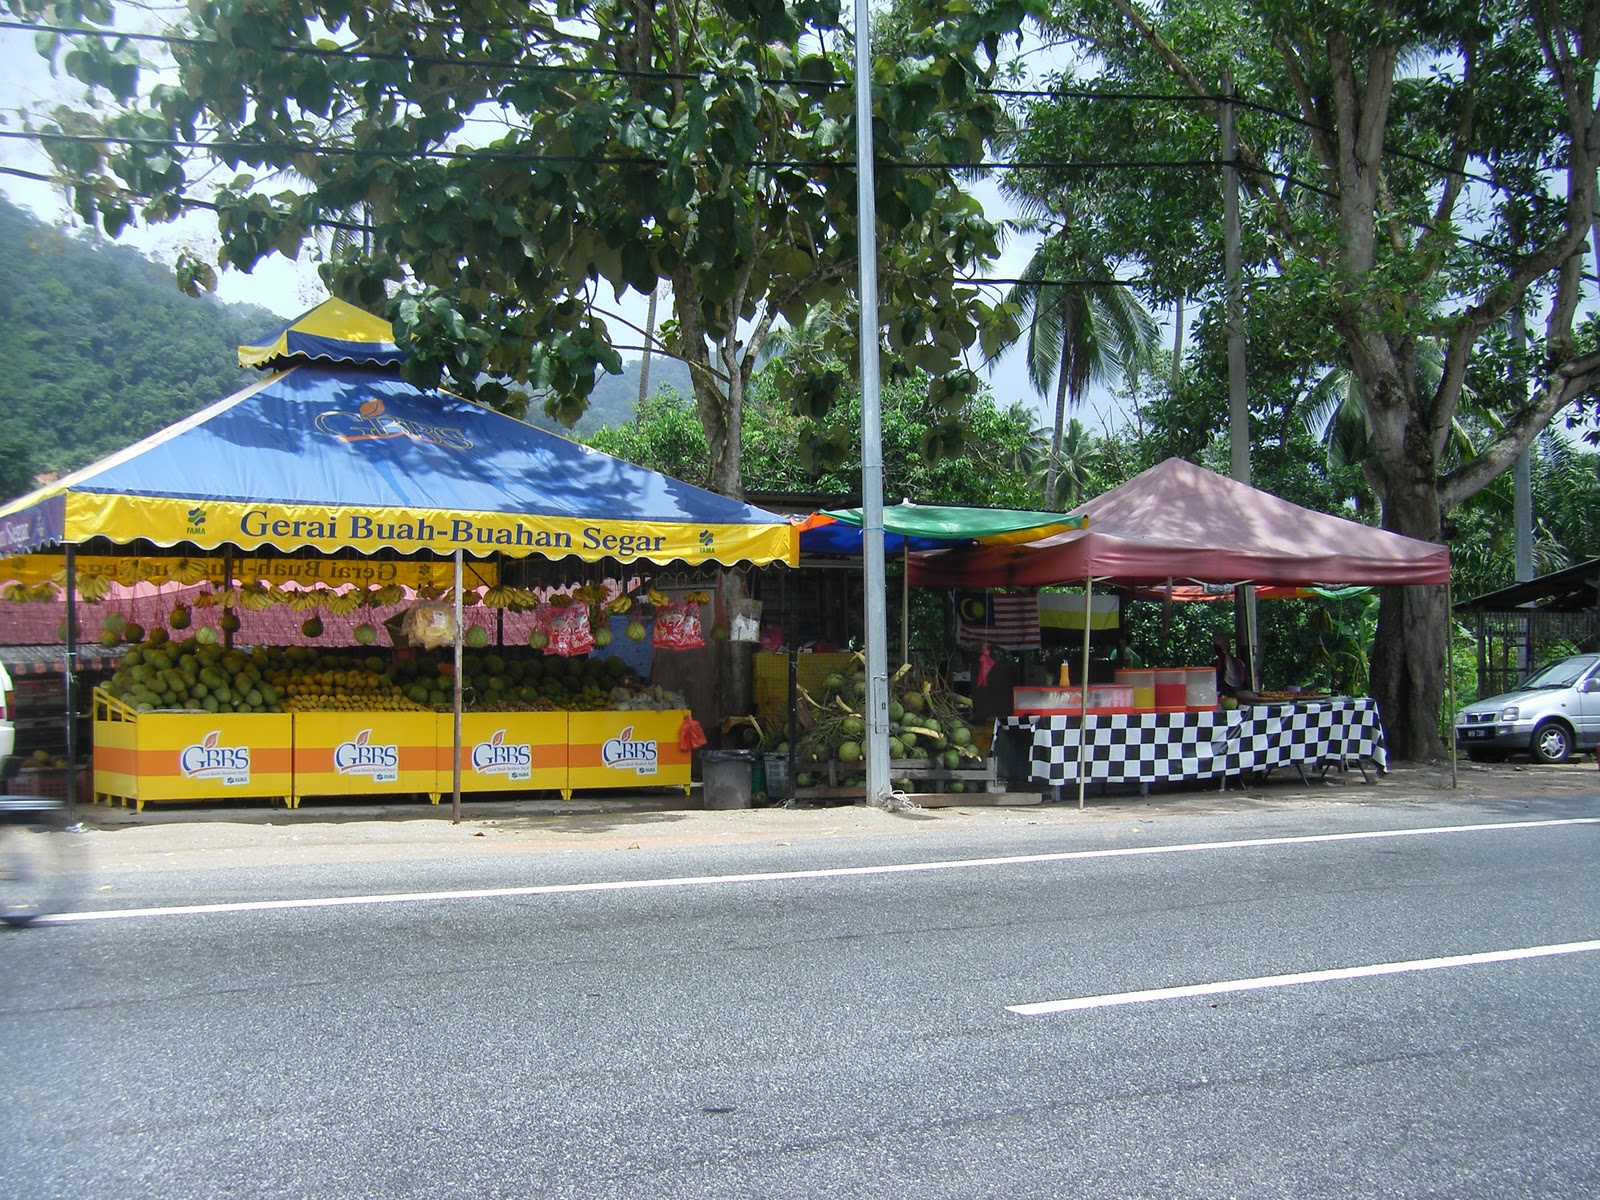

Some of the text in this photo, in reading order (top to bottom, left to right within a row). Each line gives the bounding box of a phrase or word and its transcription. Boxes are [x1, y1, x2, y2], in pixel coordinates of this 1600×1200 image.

[314, 410, 474, 450] GBBS
[187, 527, 206, 535] FAMA
[240, 510, 666, 556] Gerai Buah-Buahan Segar
[182, 745, 249, 772] GBBS
[335, 742, 397, 768] GBBS
[473, 743, 531, 767] GBBS
[603, 739, 657, 762] GBBS
